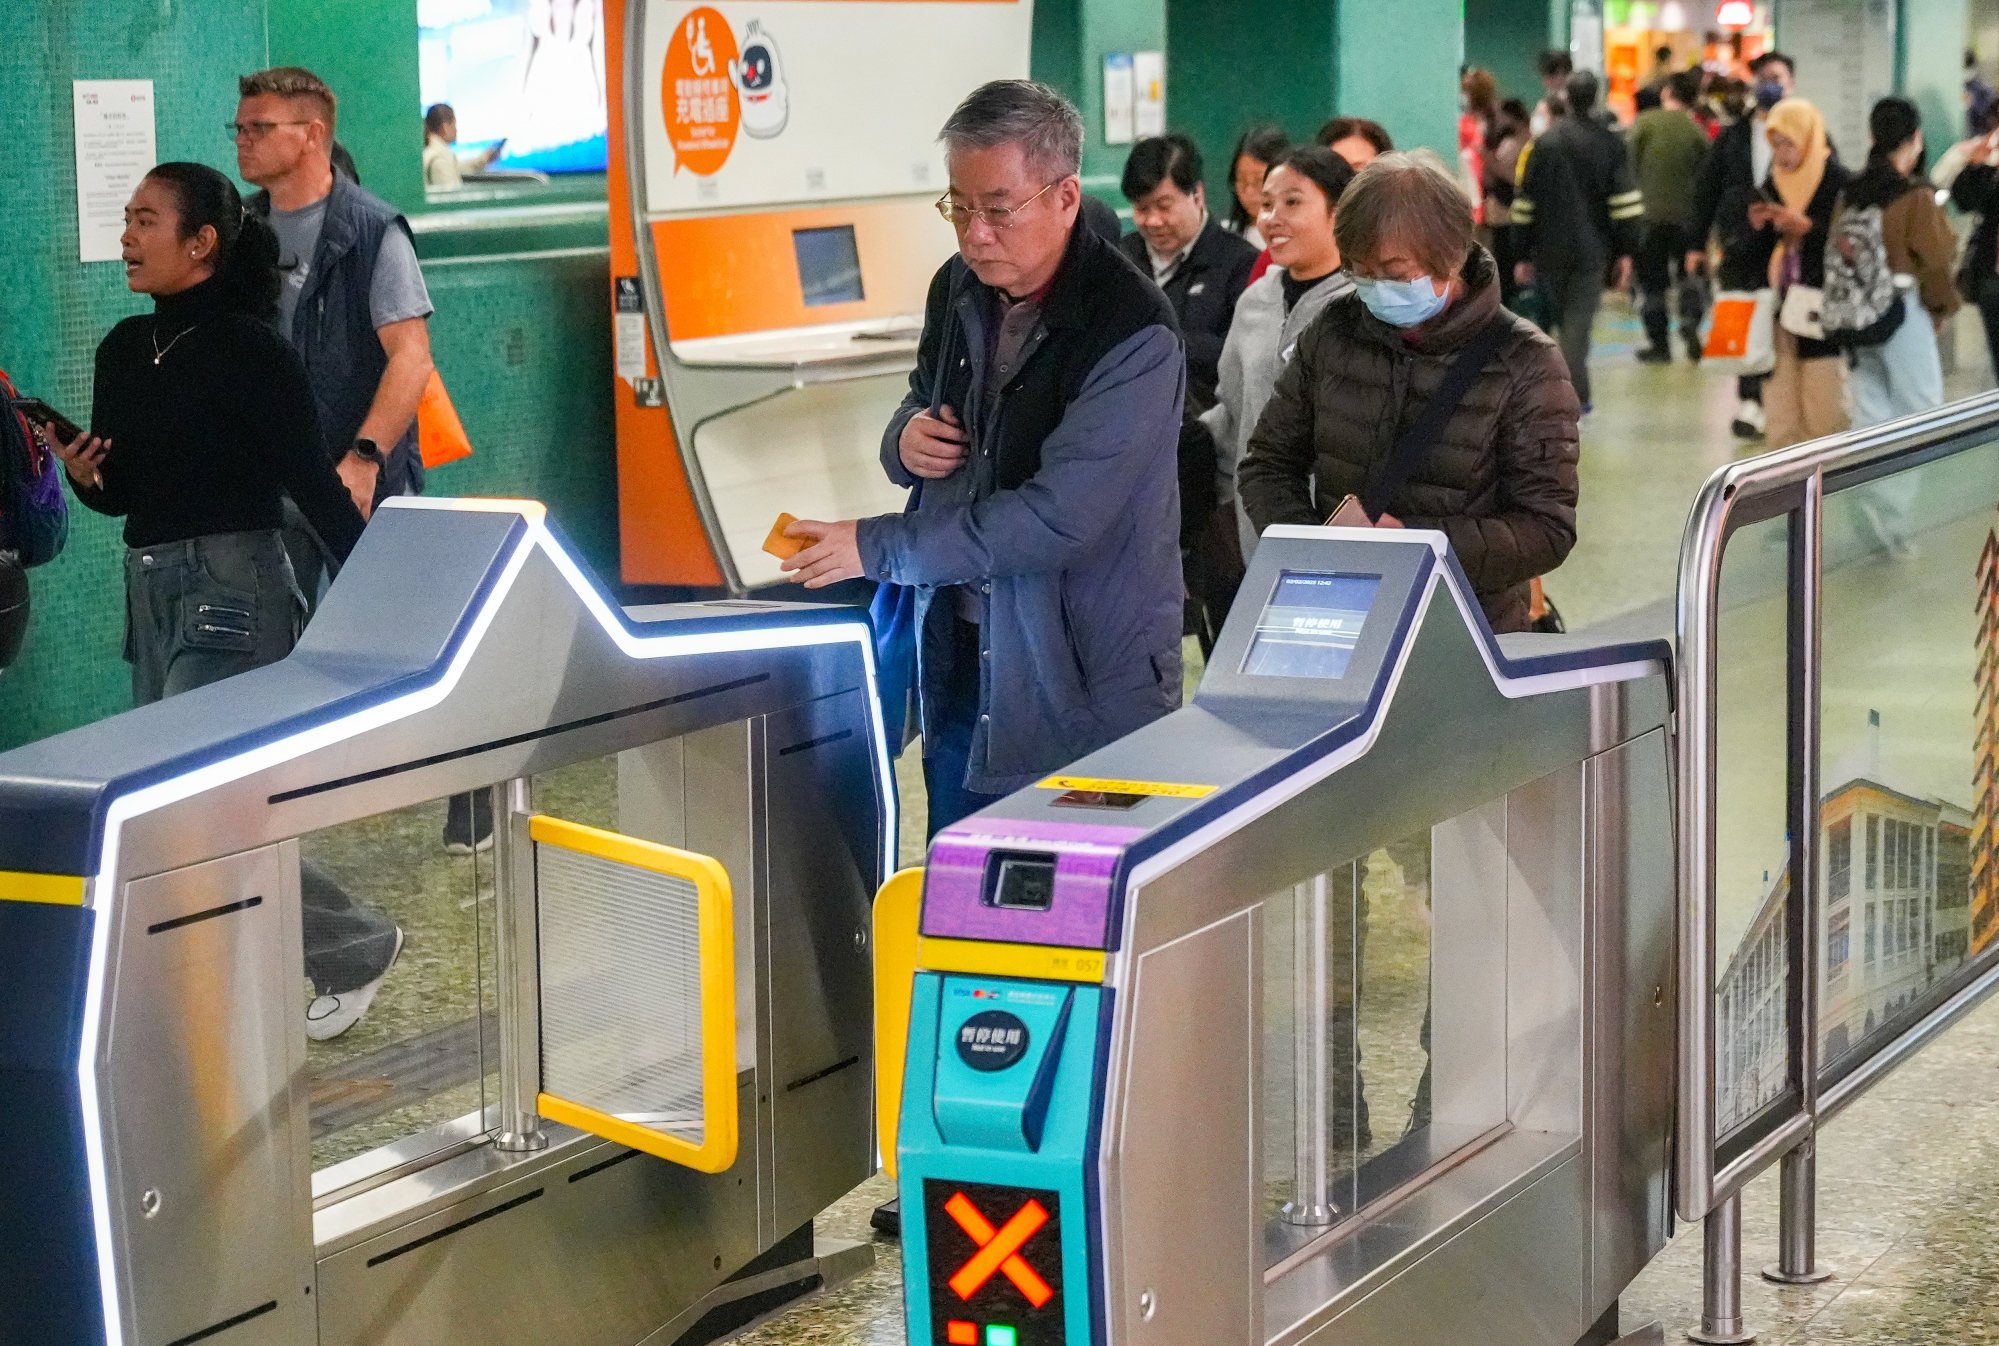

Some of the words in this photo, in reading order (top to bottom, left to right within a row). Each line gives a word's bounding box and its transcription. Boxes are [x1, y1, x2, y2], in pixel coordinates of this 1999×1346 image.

[1293, 617, 1343, 630] 暫停使用
[1076, 959, 1101, 972] 057
[961, 1026, 1022, 1045] 暫停使用
